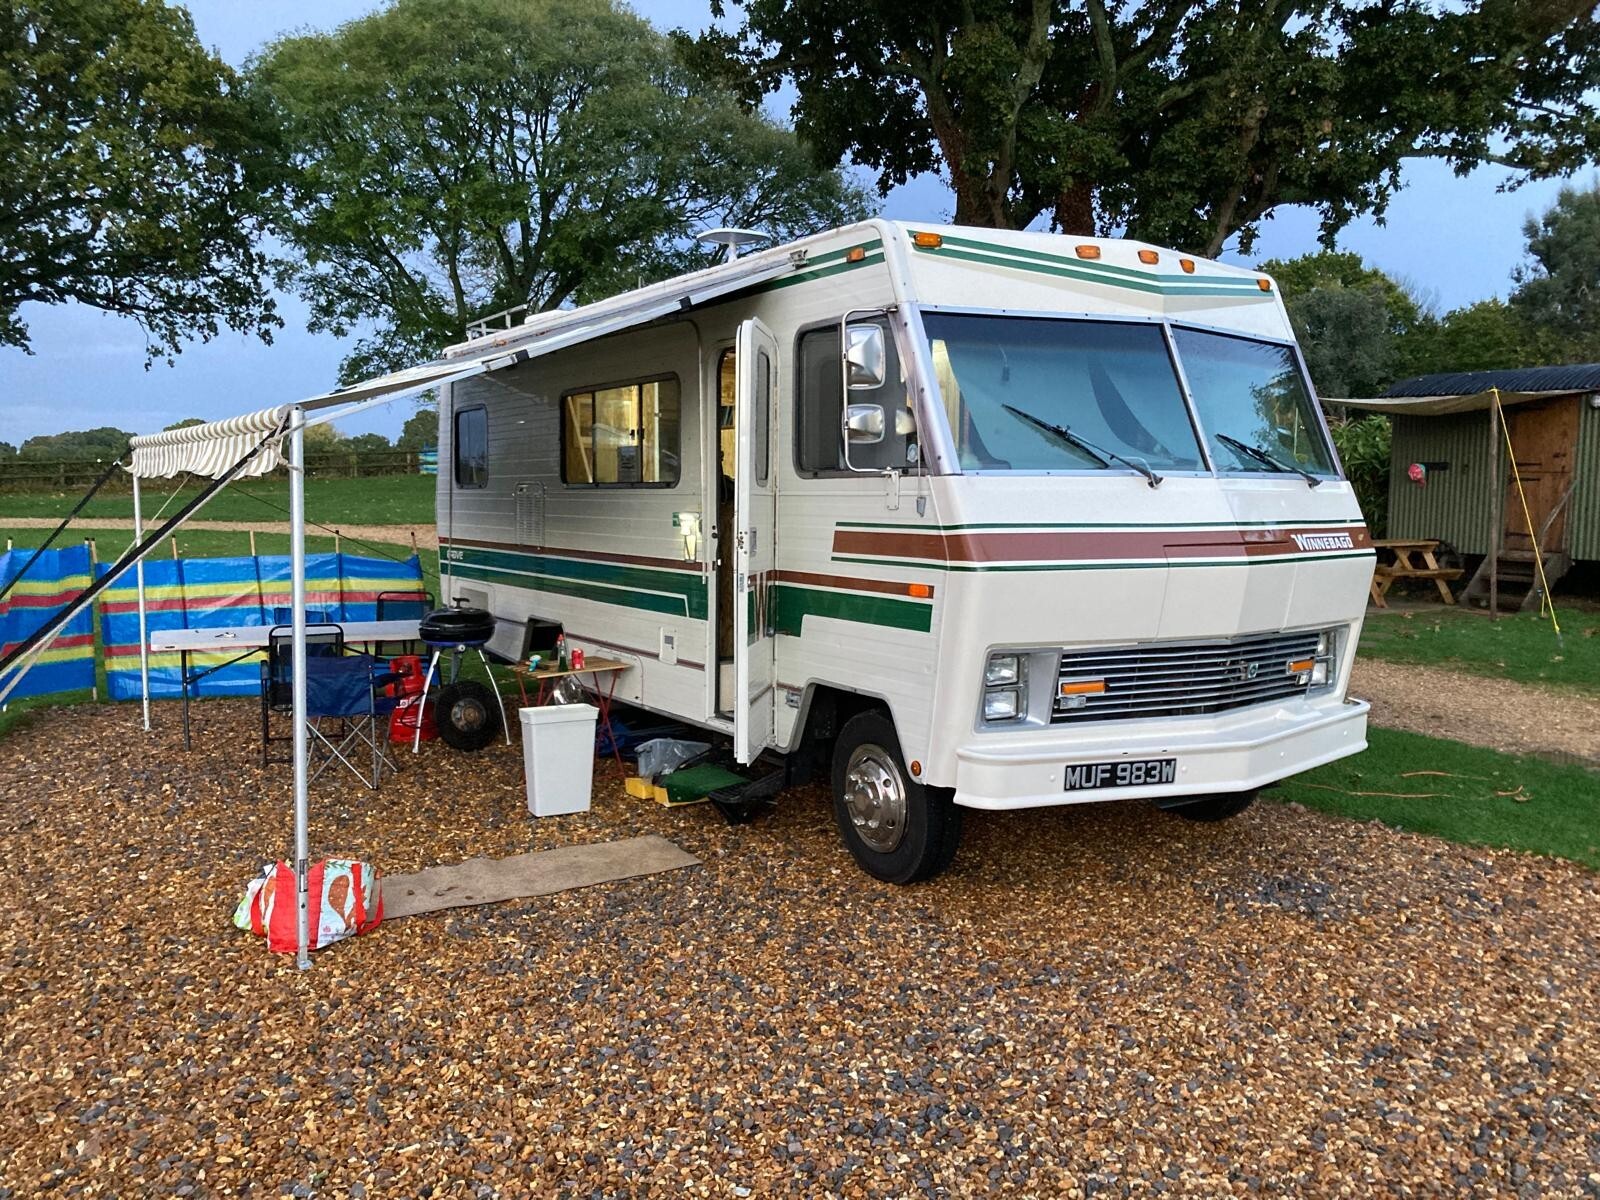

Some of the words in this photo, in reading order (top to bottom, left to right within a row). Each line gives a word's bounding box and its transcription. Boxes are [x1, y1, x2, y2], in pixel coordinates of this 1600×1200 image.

[1290, 532, 1354, 551] WINNEBAGO
[1065, 765, 1112, 790] MUF
[1116, 760, 1176, 786] 983W
